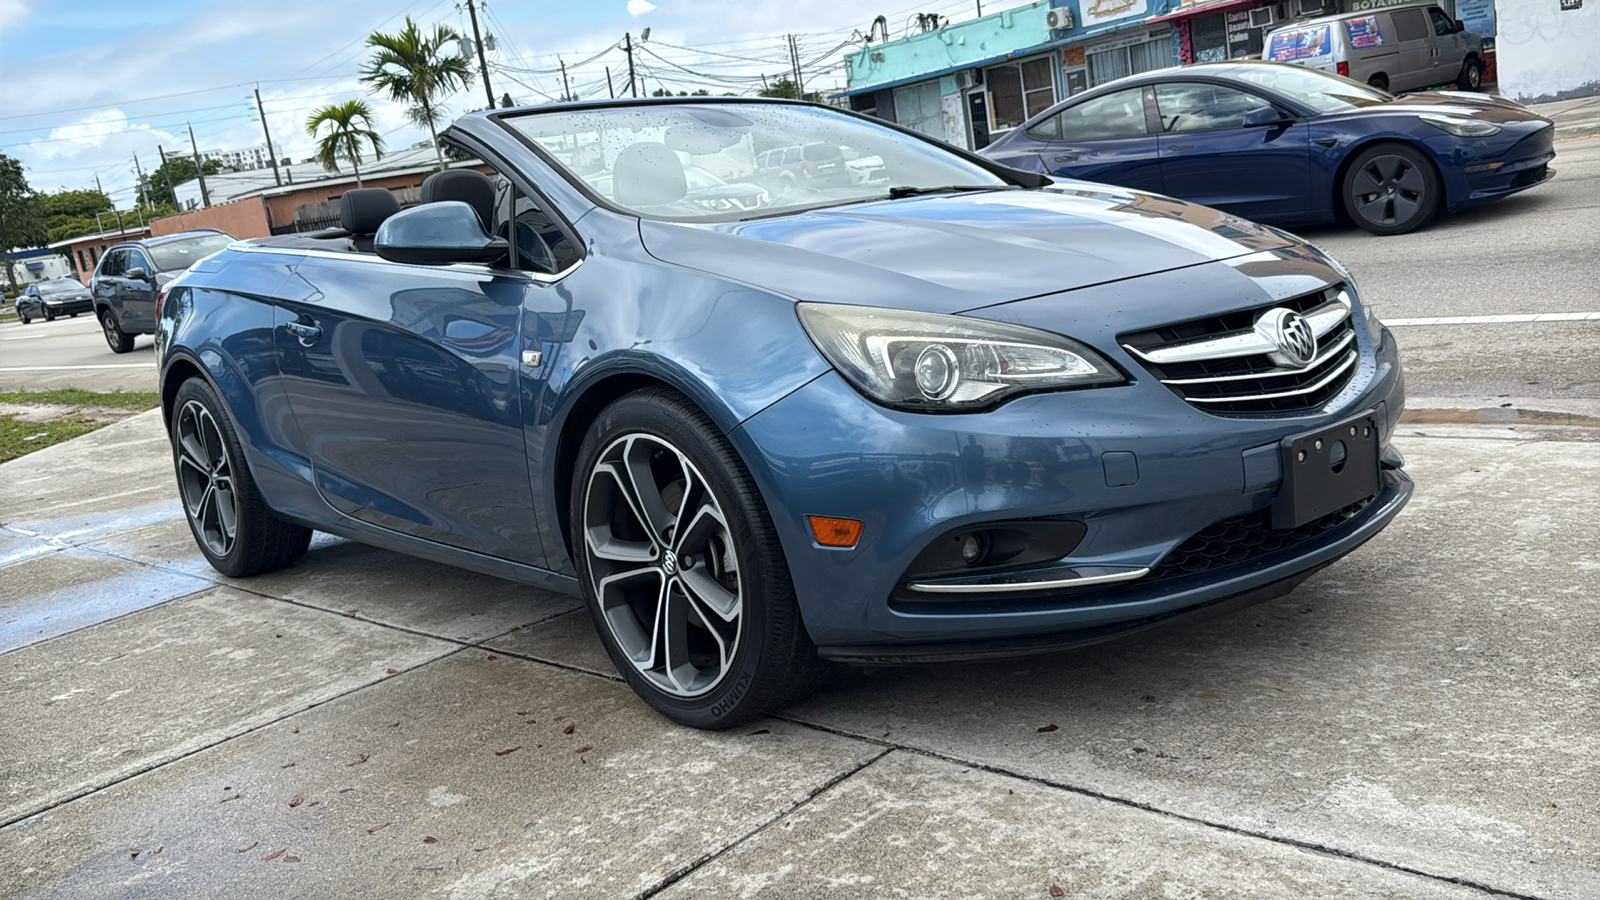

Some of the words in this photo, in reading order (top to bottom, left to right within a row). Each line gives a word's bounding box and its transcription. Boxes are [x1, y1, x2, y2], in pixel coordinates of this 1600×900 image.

[1352, 0, 1413, 11] BOTAN
[1227, 11, 1248, 23] Sarita
[1228, 21, 1250, 33] Beauty
[1229, 32, 1249, 43] Salon
[711, 670, 752, 718] KUMHO
